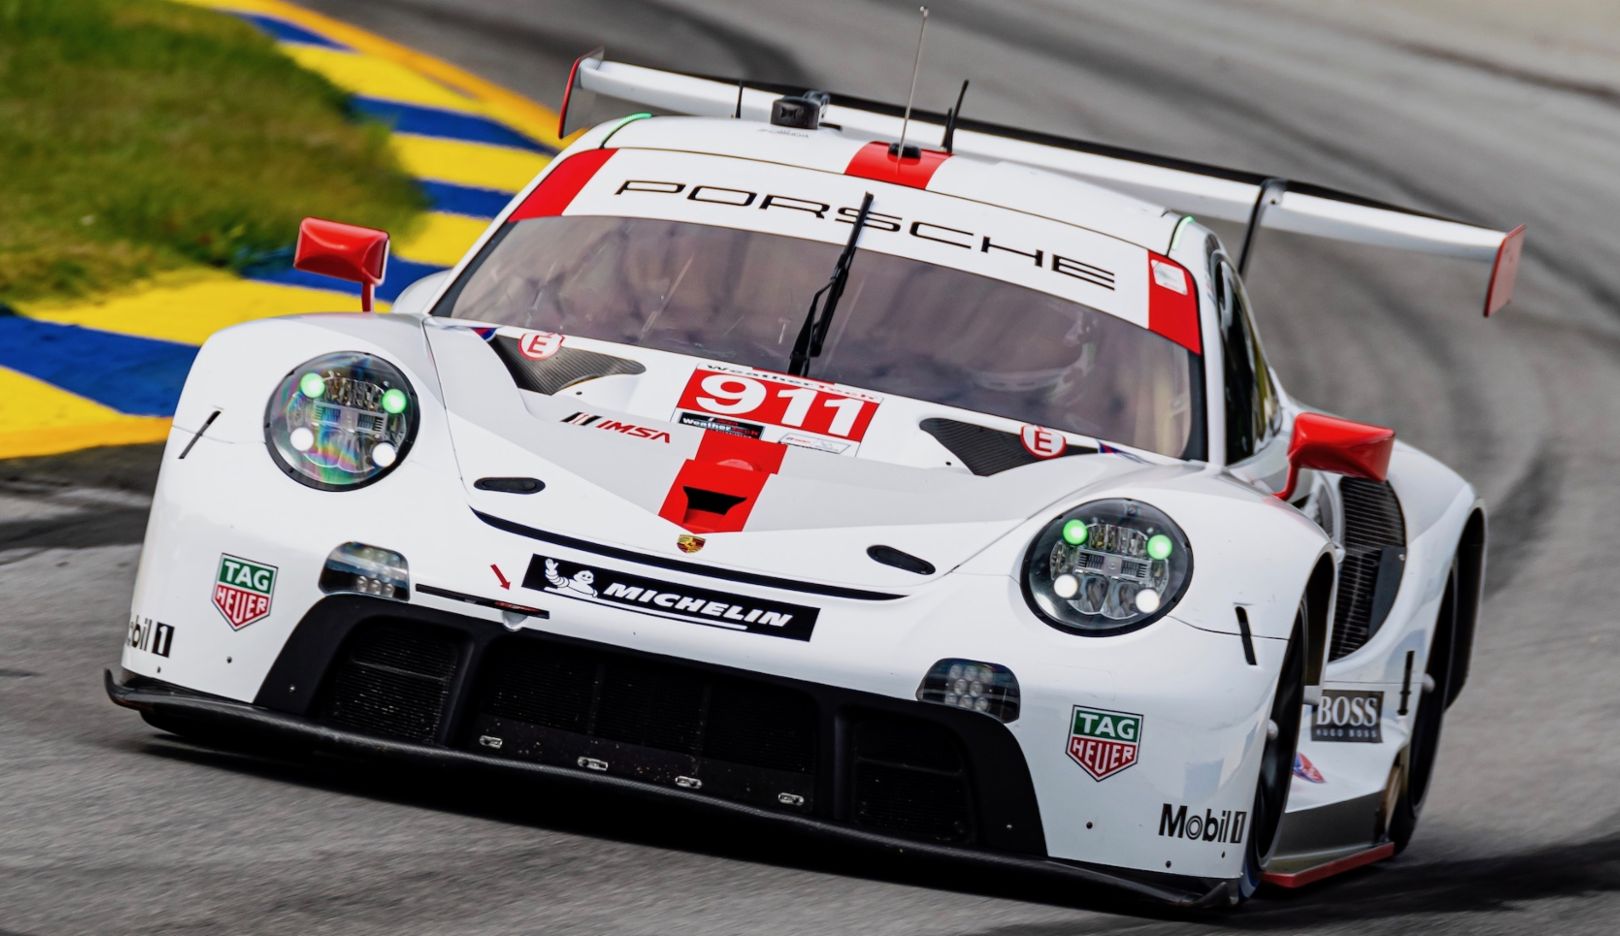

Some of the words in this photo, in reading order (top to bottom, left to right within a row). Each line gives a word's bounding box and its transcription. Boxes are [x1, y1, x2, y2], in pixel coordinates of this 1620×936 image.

[614, 180, 1115, 291] PORSCHE
[696, 374, 865, 437] 911
[595, 420, 671, 444] IMSA
[1034, 430, 1052, 453] E
[225, 560, 271, 591] TAG
[215, 586, 267, 625] HEUER
[603, 582, 794, 627] MICHELIN
[1079, 712, 1135, 740] TAG
[1315, 695, 1377, 727] BOSS
[1316, 729, 1343, 738] HUGO
[1350, 730, 1377, 739] BOSS
[1071, 738, 1135, 775] HEUER
[1158, 803, 1230, 842] Mobil
